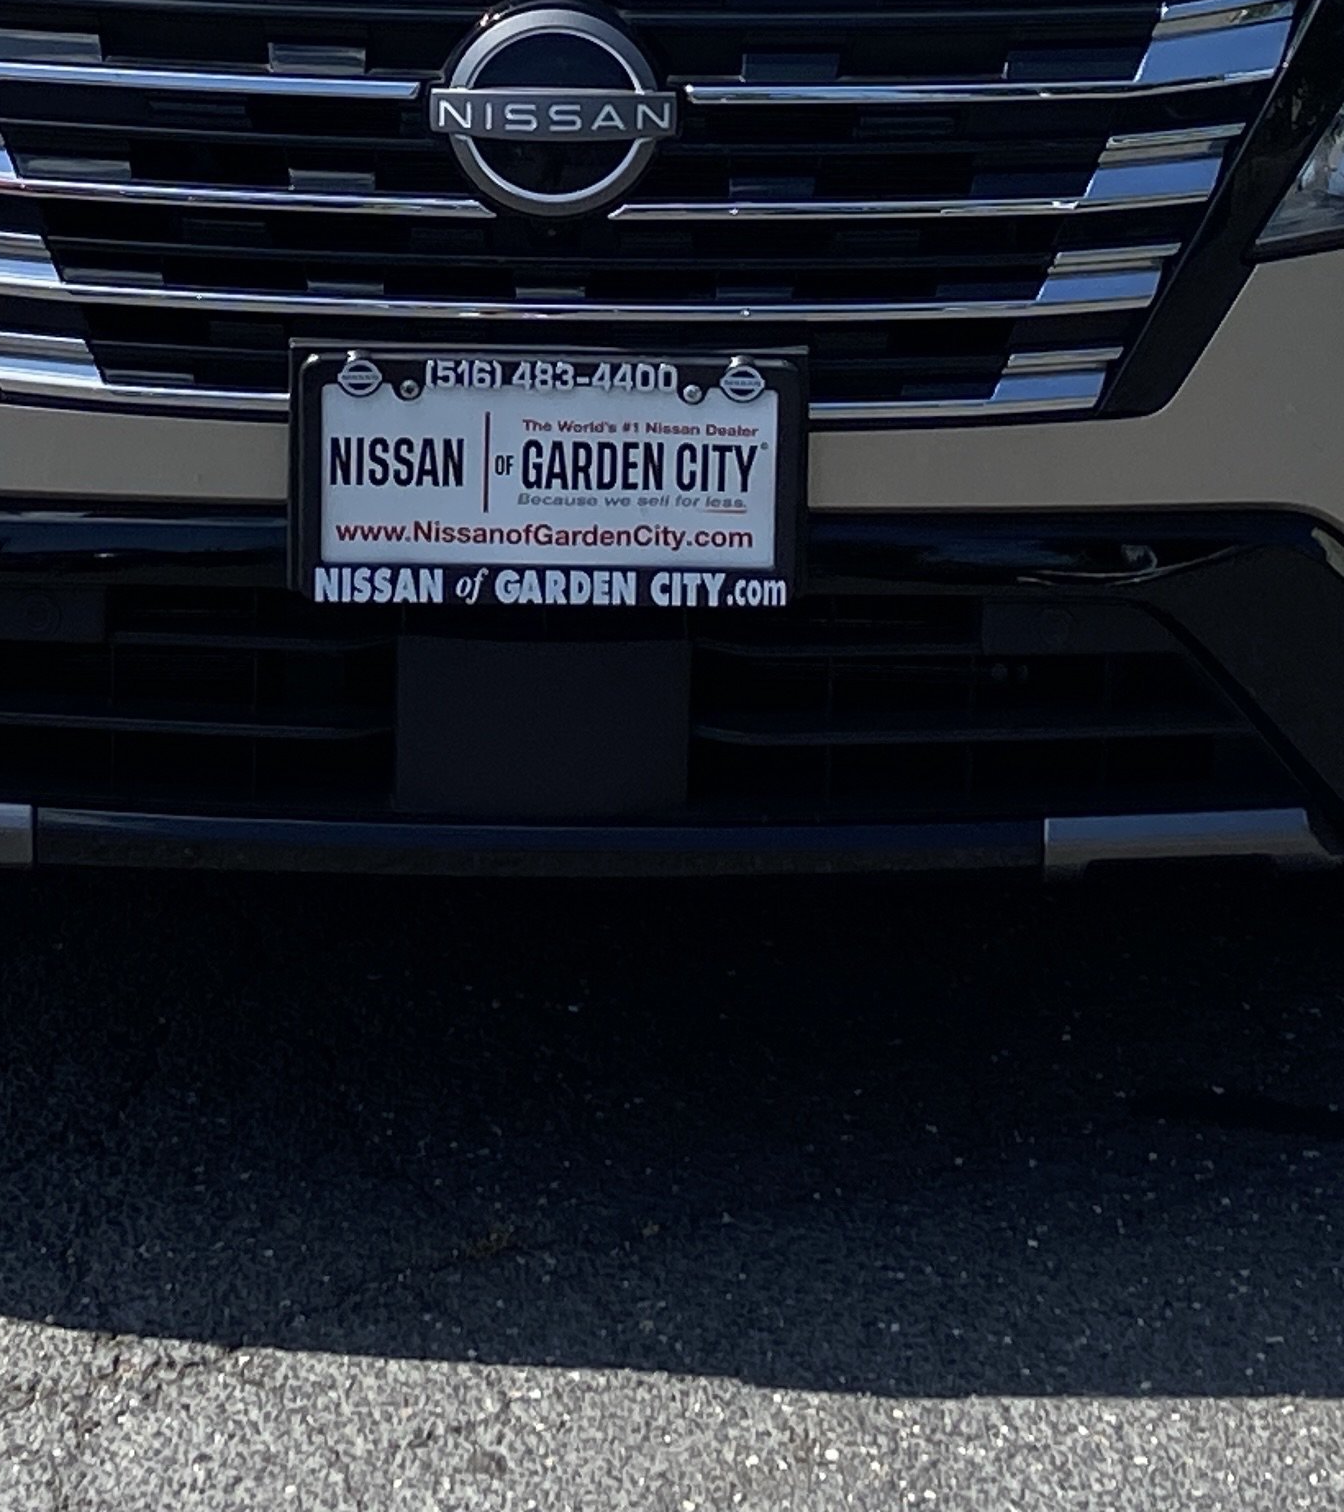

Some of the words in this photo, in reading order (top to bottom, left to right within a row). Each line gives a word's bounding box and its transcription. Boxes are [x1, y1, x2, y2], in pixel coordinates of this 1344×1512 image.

[438, 99, 670, 132] NISSAN
[425, 359, 503, 389] (516)
[512, 360, 679, 392] 483-4400
[522, 419, 552, 433] The
[557, 420, 618, 434] World's
[622, 421, 640, 434] #1
[645, 422, 701, 436] Nissan
[706, 423, 760, 438] Dealer
[330, 436, 464, 487] NISSAN
[494, 454, 515, 476] OF
[521, 439, 665, 491] GARDEN
[676, 442, 758, 493] CITY
[517, 492, 599, 507] Because
[606, 496, 631, 507] we
[637, 493, 670, 508] sell
[674, 494, 701, 508] for
[705, 495, 747, 510] less.
[335, 520, 754, 551] www.NissanofGardenCity.com
[314, 567, 444, 604] NISSAN
[455, 567, 490, 606] of
[494, 569, 637, 606] GARDEN
[650, 571, 787, 607] CITY.com
